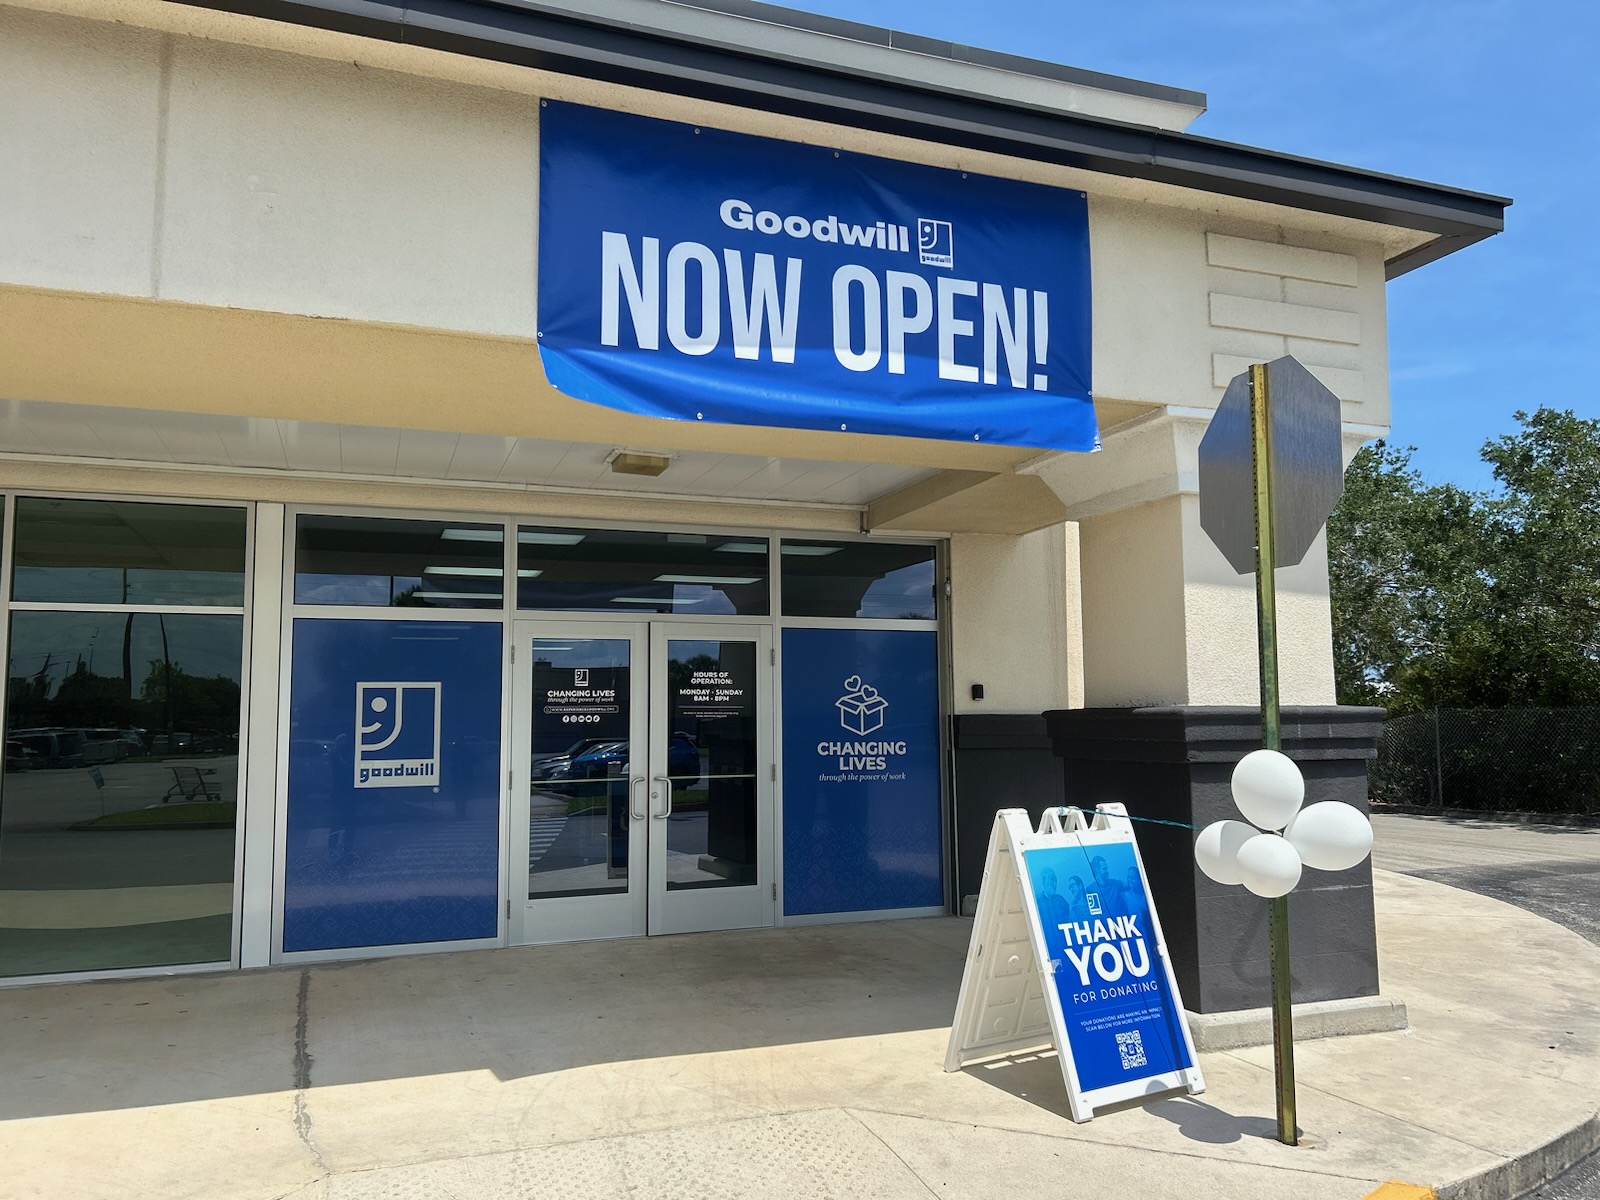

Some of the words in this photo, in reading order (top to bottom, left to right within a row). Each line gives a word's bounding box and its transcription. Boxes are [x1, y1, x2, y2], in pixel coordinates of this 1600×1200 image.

[719, 198, 909, 253] Goodwill
[921, 255, 952, 264] goodwill
[601, 231, 802, 364] NOW
[832, 264, 1048, 392] OPEN!
[817, 741, 907, 756] CHANGING
[839, 757, 887, 771] LIVES
[360, 763, 434, 783] goodwill
[819, 773, 846, 783] through
[847, 772, 859, 781] the
[859, 773, 880, 782] power
[881, 772, 890, 782] of
[889, 772, 907, 780] work
[1058, 914, 1143, 946] THANK
[1064, 938, 1150, 986] YOU
[1073, 991, 1097, 1005] FOR
[1100, 980, 1158, 1000] DONATING
[1093, 1015, 1117, 1024] DONATIONS
[1125, 1010, 1141, 1018] MAKING
[1098, 1022, 1113, 1030] BELOW
